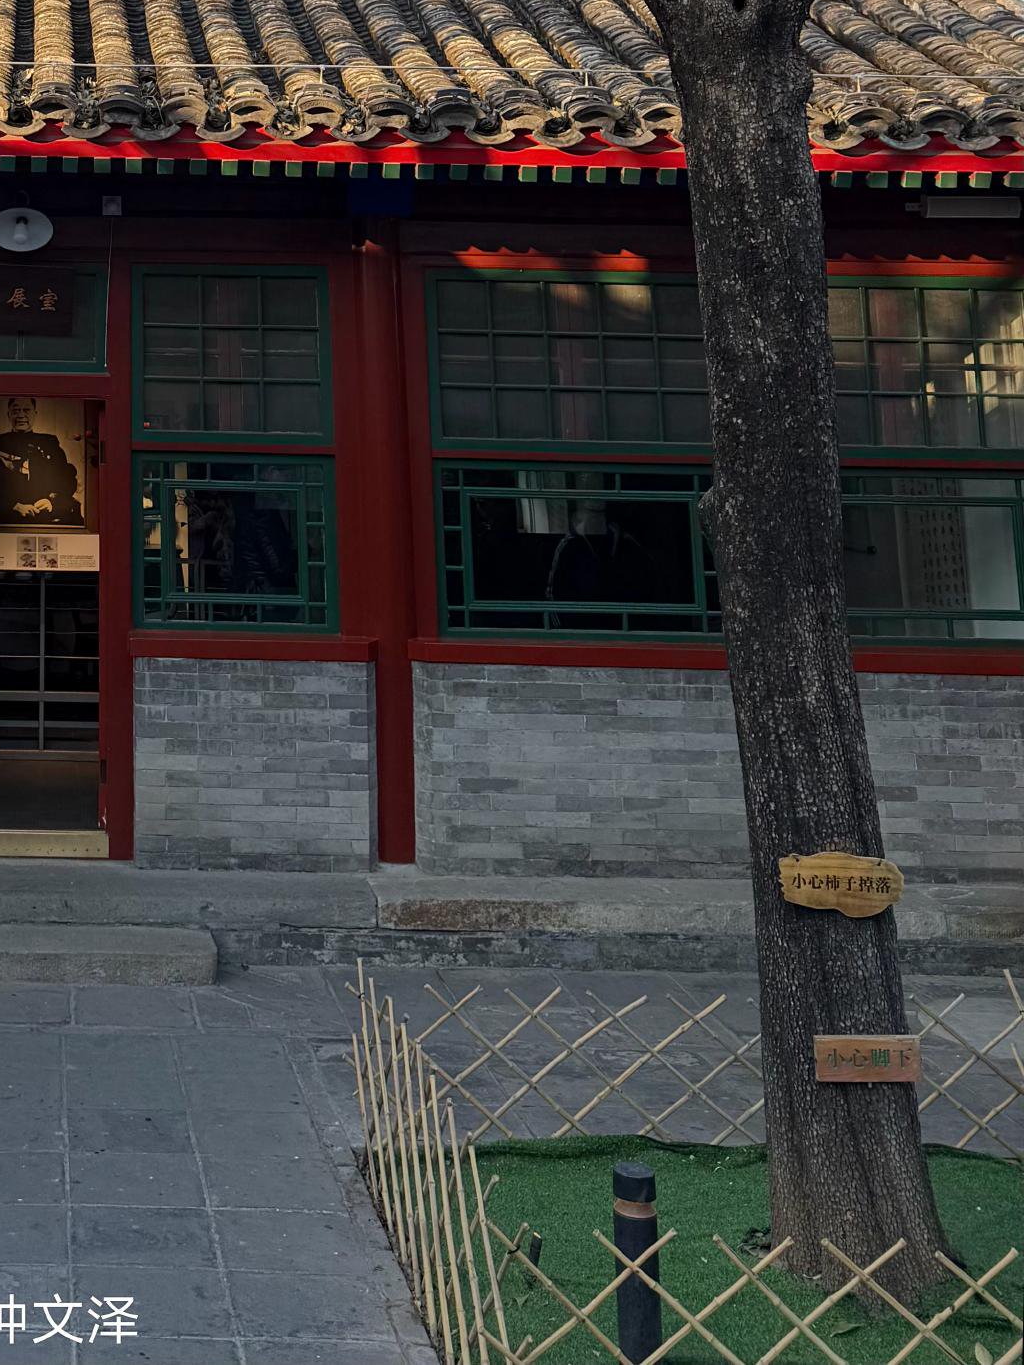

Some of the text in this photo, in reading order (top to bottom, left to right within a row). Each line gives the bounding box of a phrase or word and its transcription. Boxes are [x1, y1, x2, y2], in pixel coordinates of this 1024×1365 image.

[792, 872, 892, 894] 小心柿子掉落
[826, 1047, 914, 1068] 小心脚下
